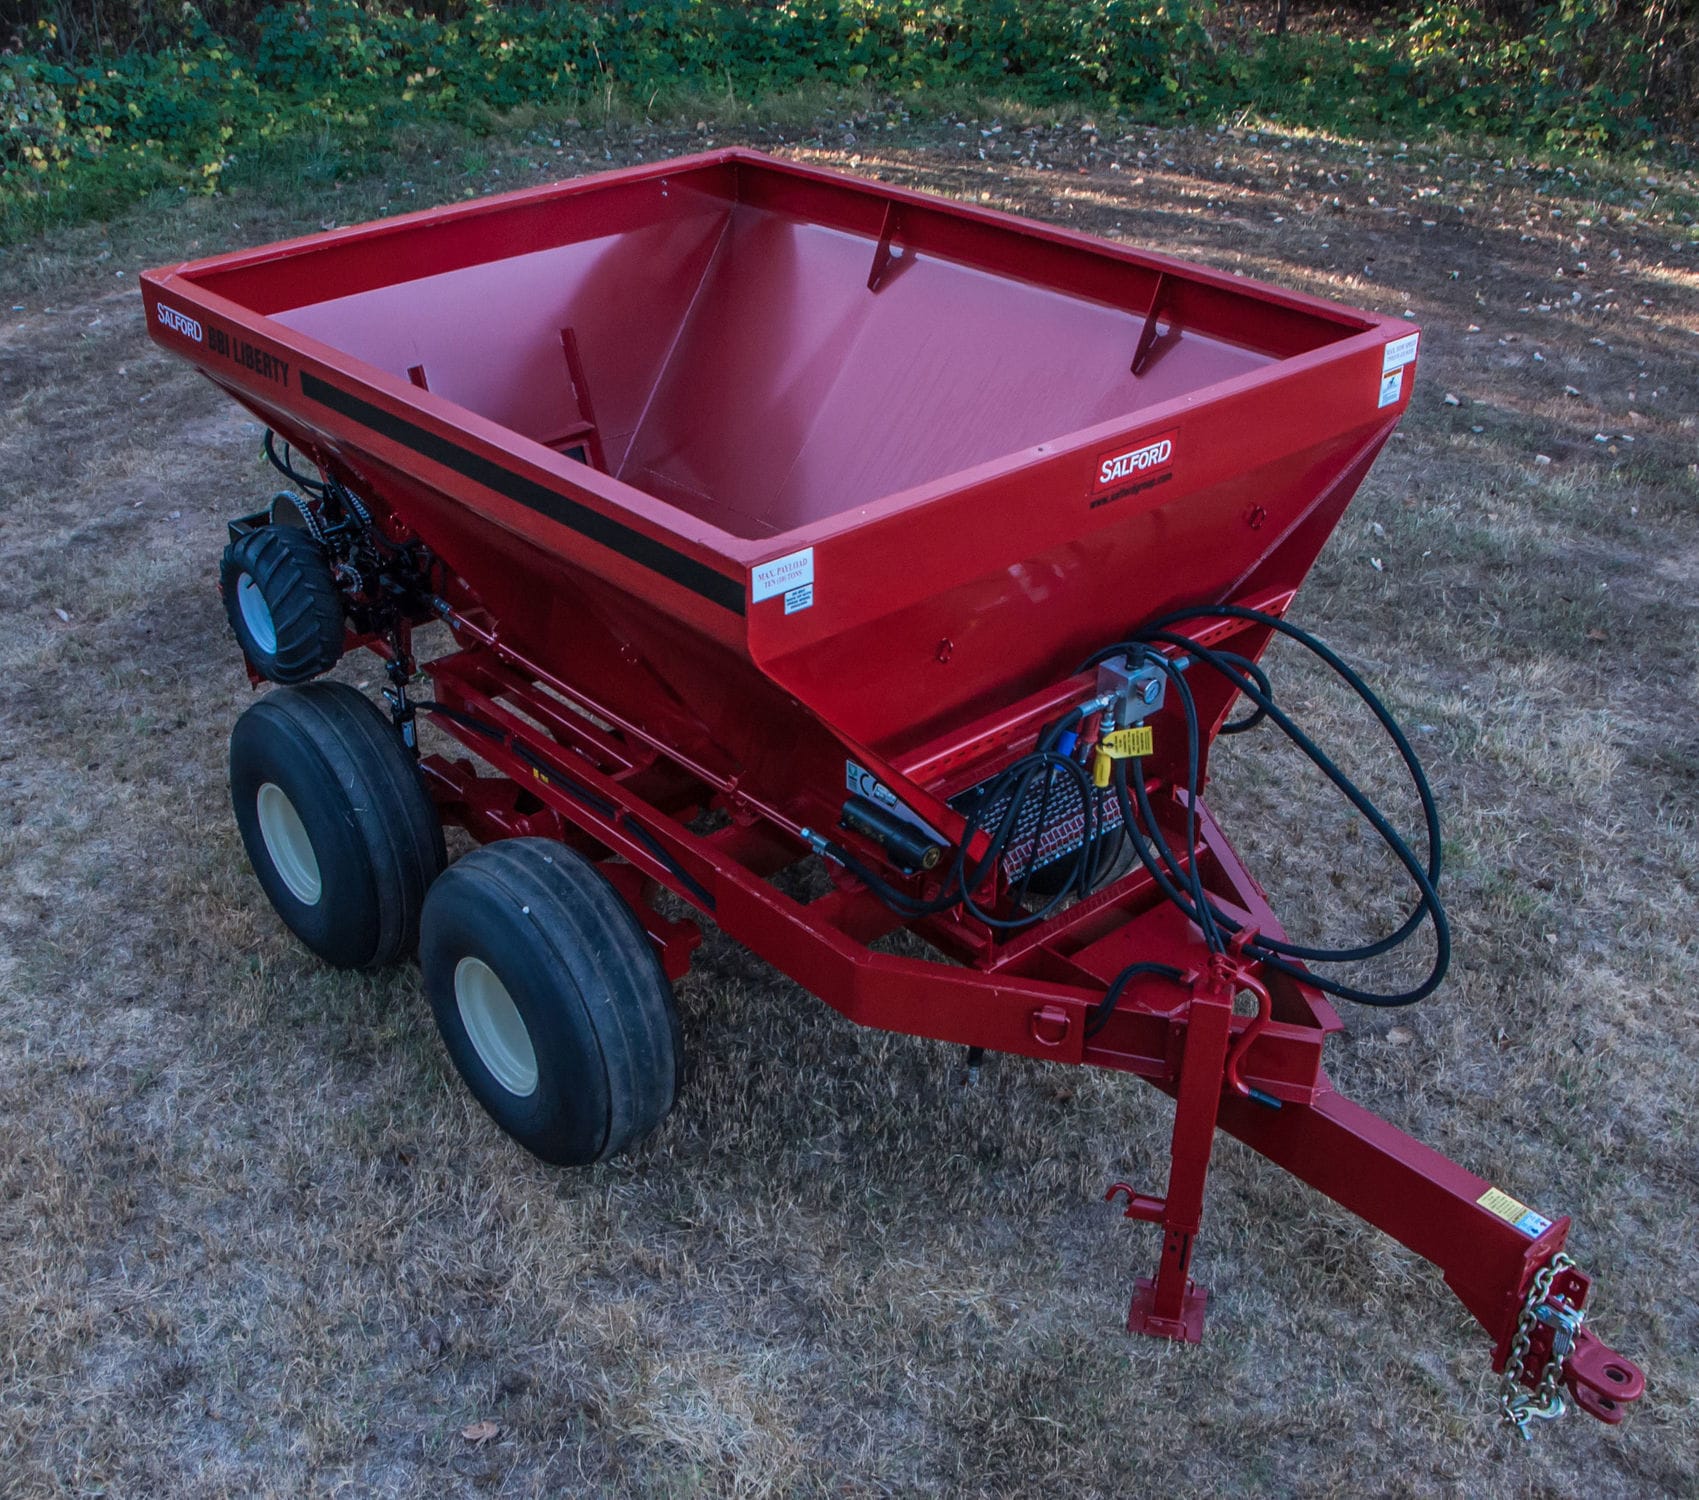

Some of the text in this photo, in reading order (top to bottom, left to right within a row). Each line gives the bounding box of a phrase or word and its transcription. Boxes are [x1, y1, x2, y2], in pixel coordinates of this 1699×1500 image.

[157, 302, 203, 342] SALFORD
[207, 325, 289, 387] BBI LIBERTY
[1099, 439, 1172, 483] SALFORD
[777, 558, 808, 576] PAYLOAD
